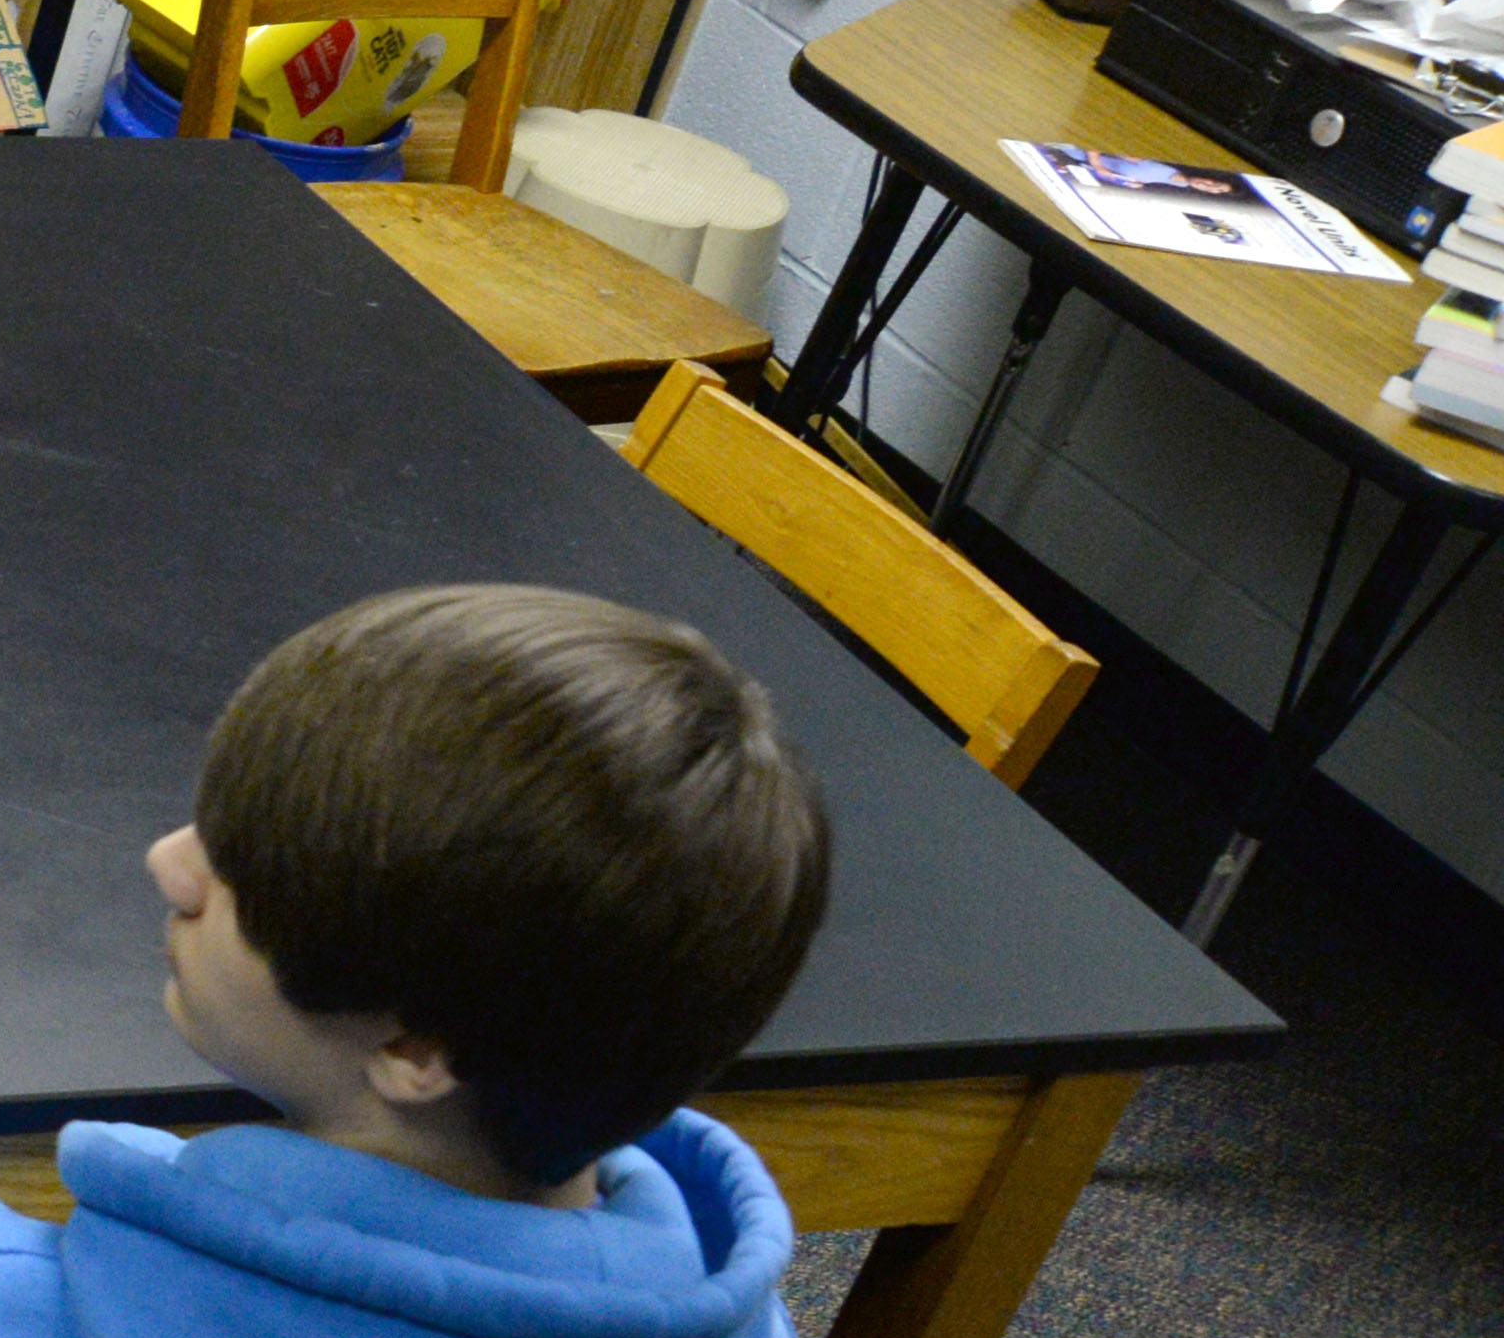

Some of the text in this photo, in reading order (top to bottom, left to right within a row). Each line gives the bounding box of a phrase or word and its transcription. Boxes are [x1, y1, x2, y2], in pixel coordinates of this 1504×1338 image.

[370, 36, 389, 74] CATS
[384, 25, 401, 60] TIDY
[1276, 184, 1362, 258] Novel Units
